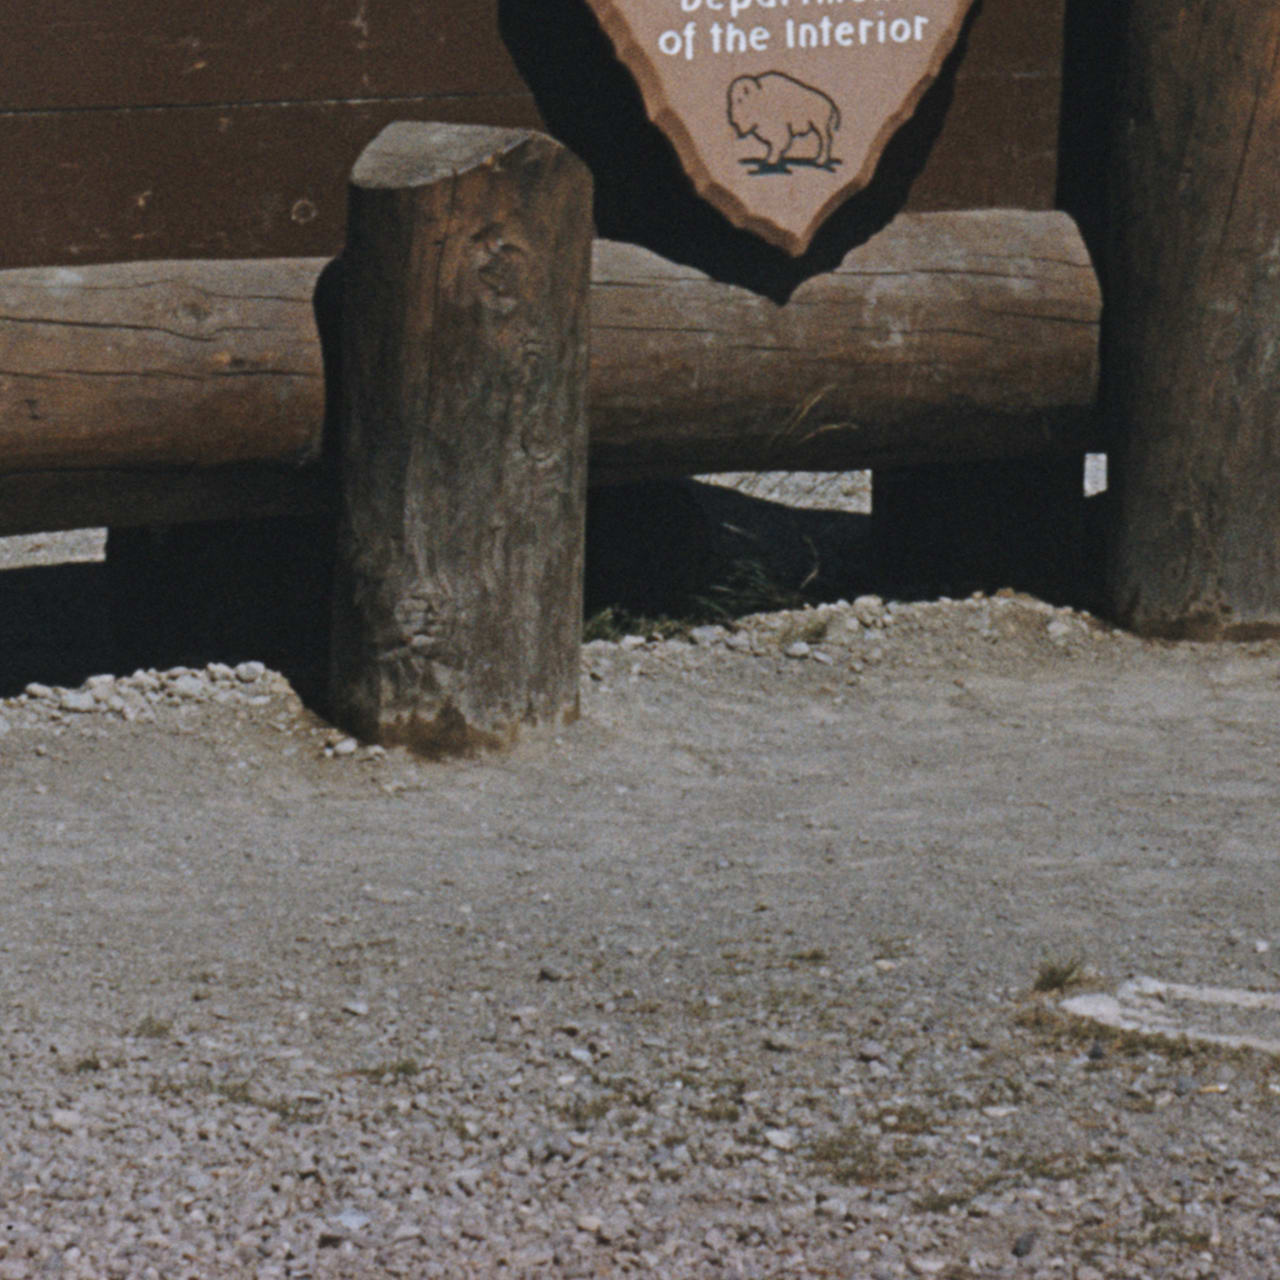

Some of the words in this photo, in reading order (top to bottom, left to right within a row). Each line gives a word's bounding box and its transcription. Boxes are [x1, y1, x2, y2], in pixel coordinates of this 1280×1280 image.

[658, 21, 697, 61] of
[709, 22, 771, 53] the
[785, 10, 929, 49] Interior
